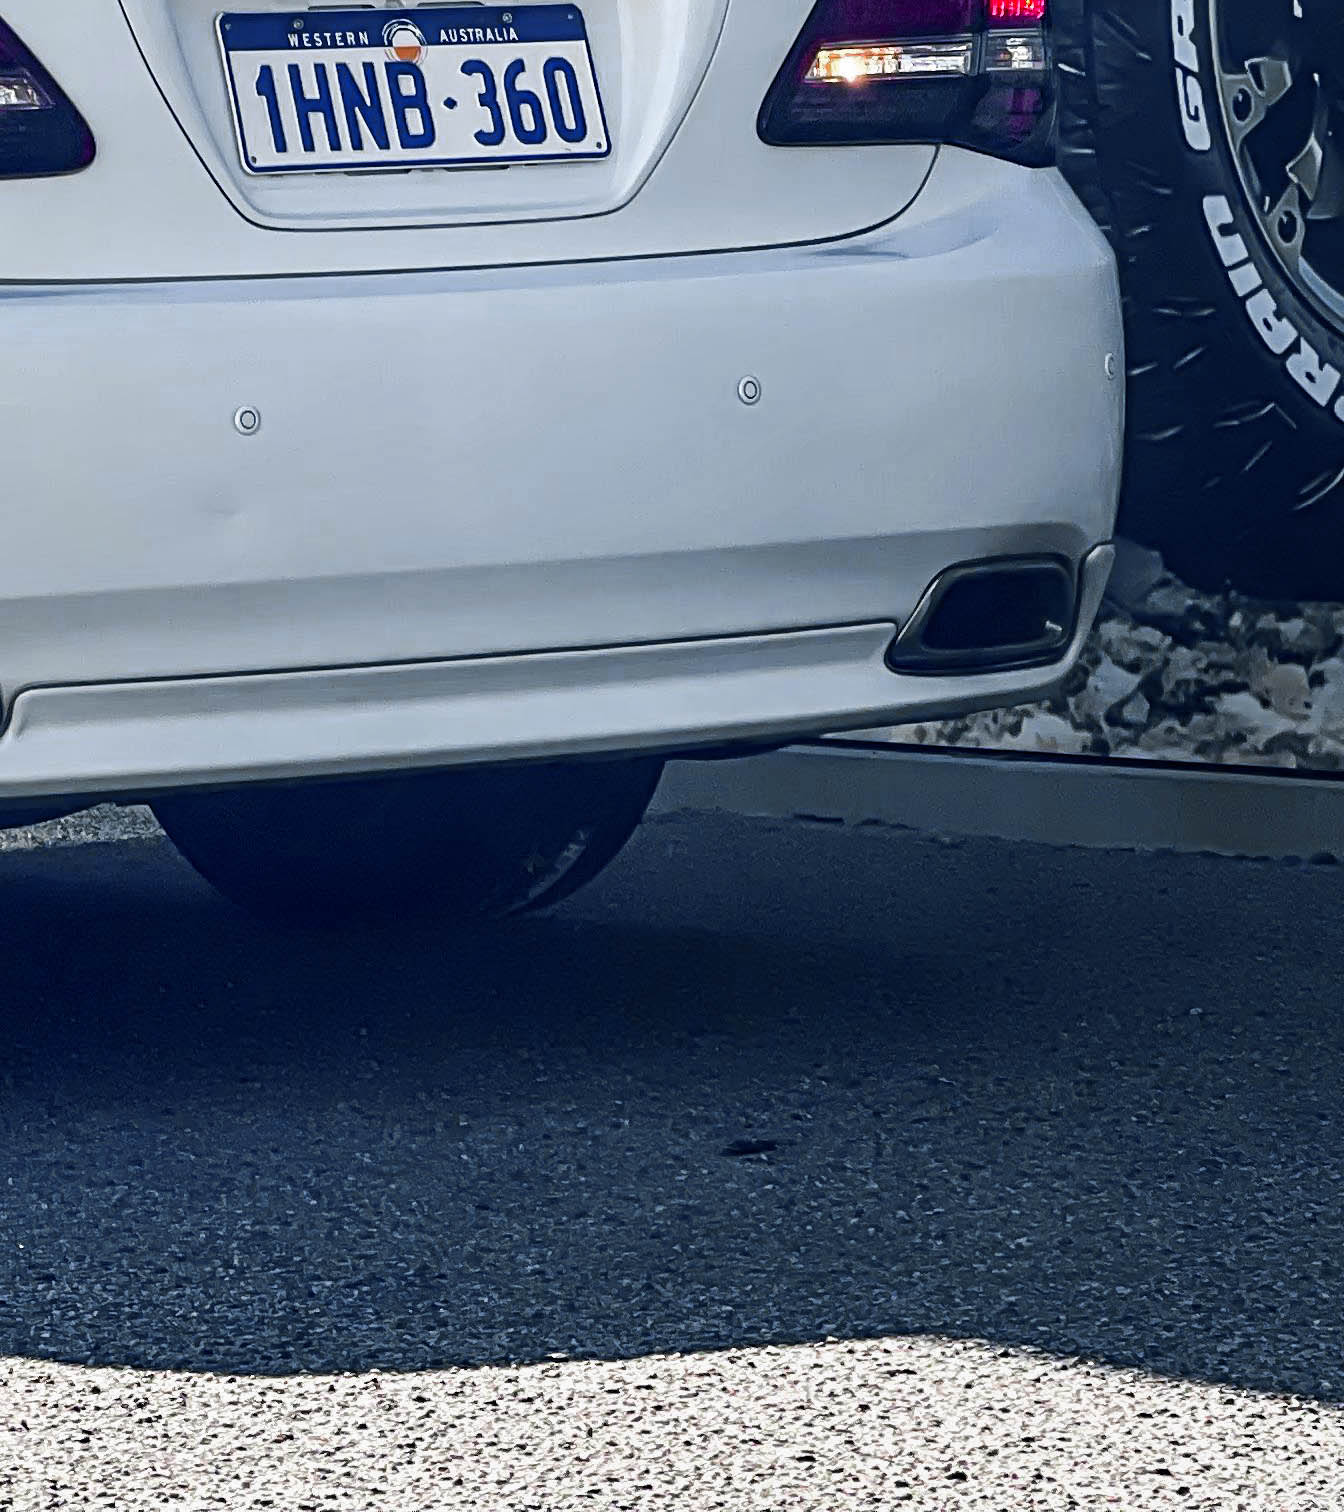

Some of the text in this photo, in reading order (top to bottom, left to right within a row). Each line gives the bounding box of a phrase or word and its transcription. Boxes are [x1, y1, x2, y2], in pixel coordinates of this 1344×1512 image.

[287, 27, 520, 48] WESTERN AUSTRALIA
[1202, 195, 1344, 422] RAIN
